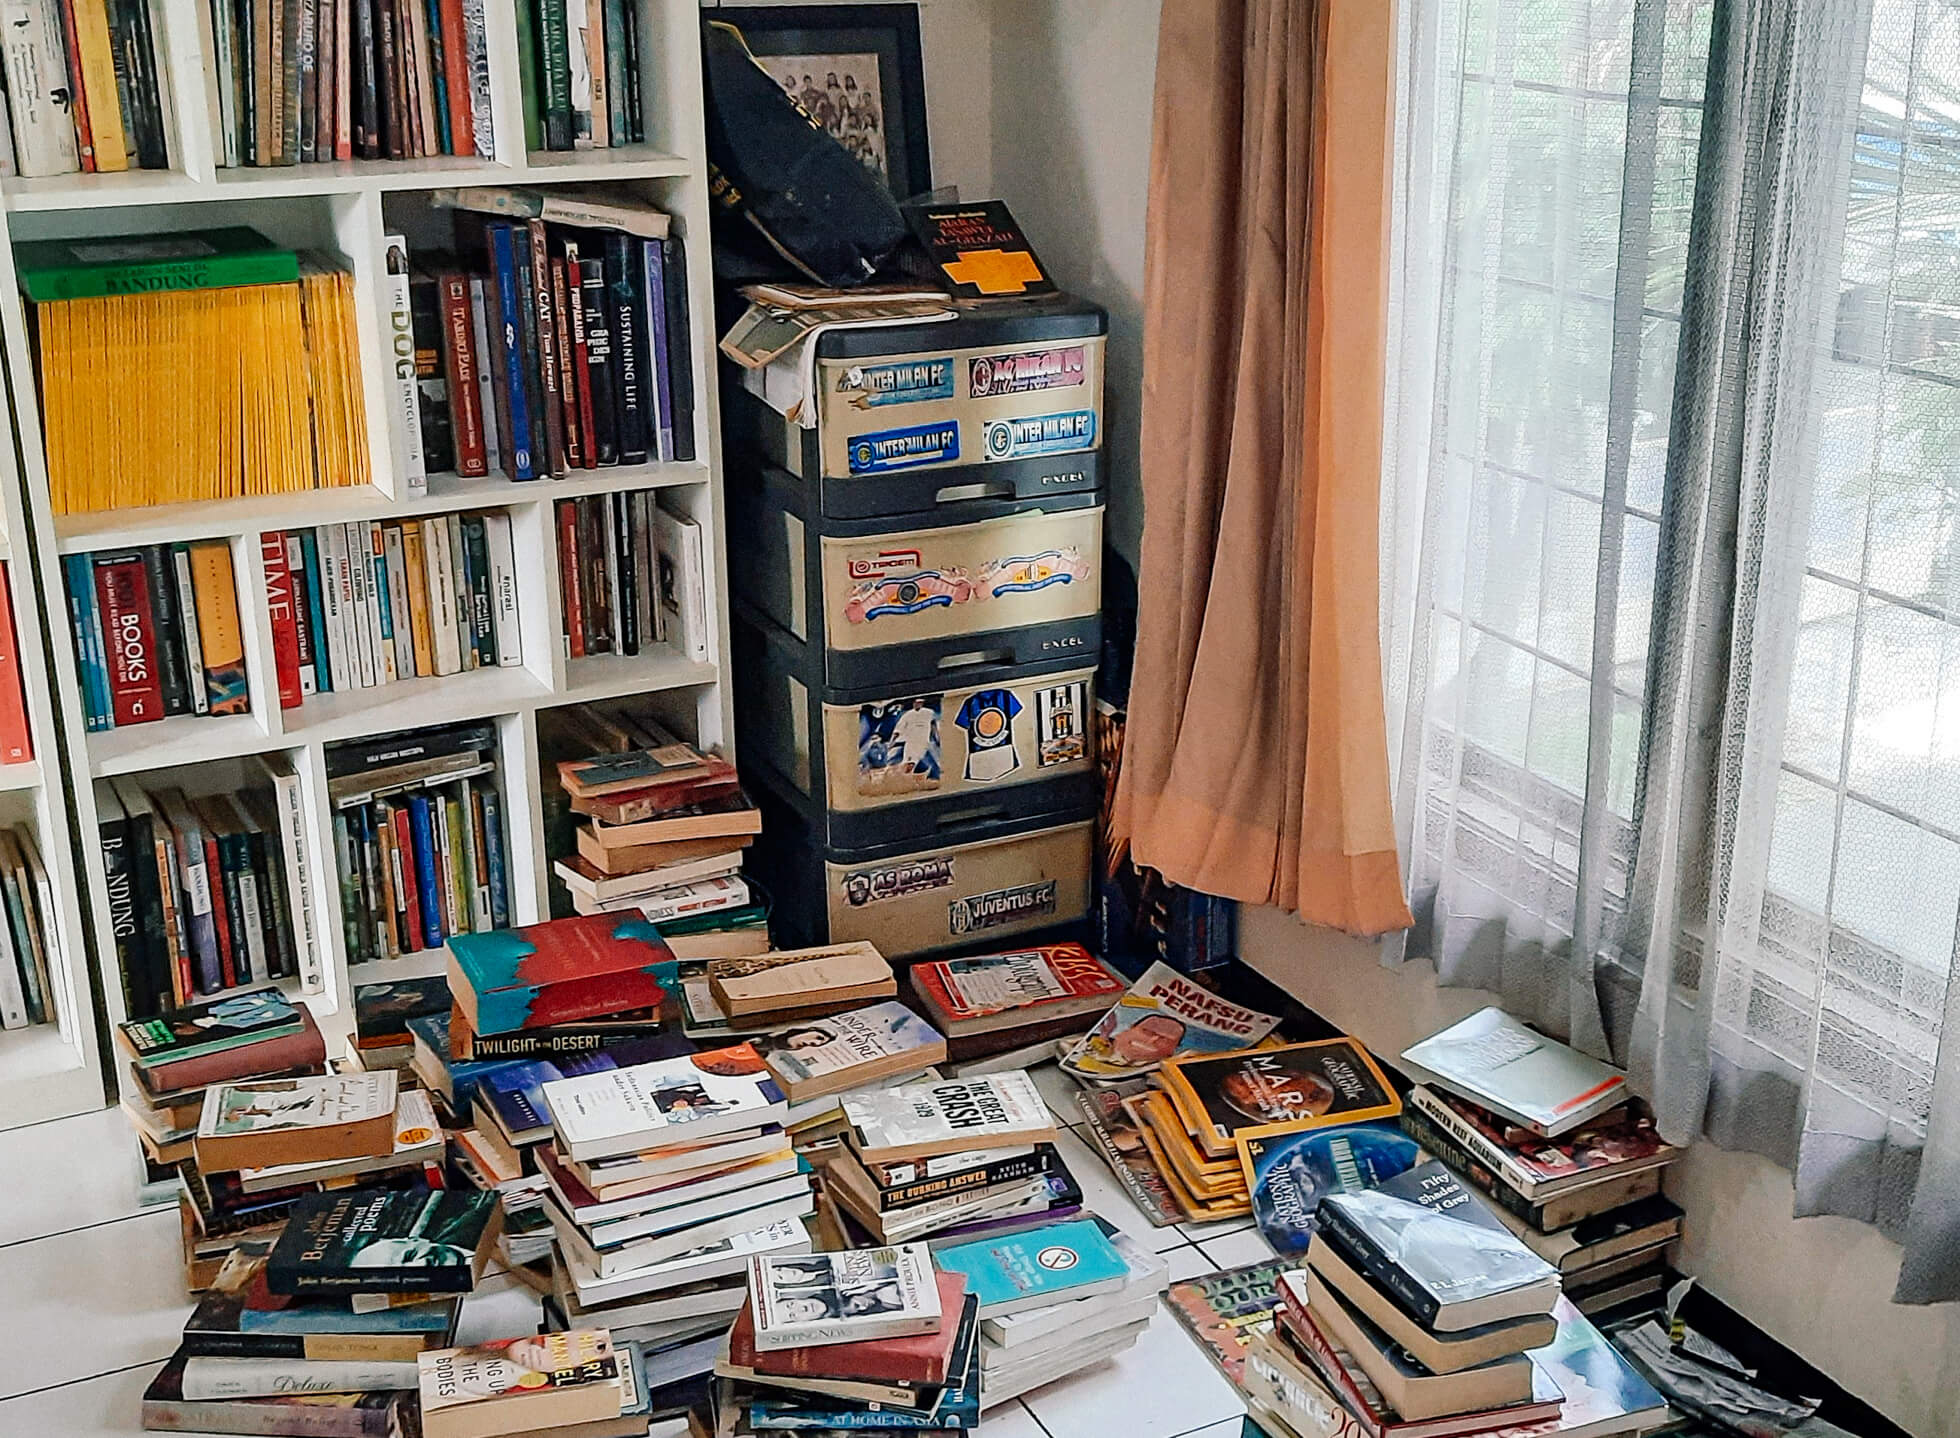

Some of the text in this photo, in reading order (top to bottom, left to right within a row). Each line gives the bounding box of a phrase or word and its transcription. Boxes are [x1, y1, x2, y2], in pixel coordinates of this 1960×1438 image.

[106, 273, 208, 293] BANDUNG
[538, 292, 552, 322] CAT
[571, 287, 585, 344] PROPAGANDA
[620, 305, 637, 410] SUSTAINING LIFE
[391, 287, 418, 461] THE DOG ENCYCLOPEDIA
[896, 367, 929, 388] MILAN
[931, 365, 945, 386] FC
[875, 430, 954, 459] INTER MILAN FC
[1013, 415, 1089, 444] INTER MILAN FC
[104, 571, 116, 588] YOU
[261, 533, 290, 621] TIME
[503, 575, 514, 611] #narasi
[120, 614, 147, 681] BOOKS
[1042, 637, 1084, 650] EXCEL
[874, 861, 950, 891] AS ROMA
[972, 889, 1052, 918] JUVENTUS FC
[1150, 984, 1253, 1034] PERANG
[1169, 979, 1255, 1022] NAFSU
[837, 1013, 876, 1043] UNDER
[475, 1037, 536, 1055] TWILIGHT
[553, 1034, 601, 1051] DESERT
[847, 1036, 879, 1059] WIRE
[968, 1081, 1010, 1124] THE GREAT
[1252, 1056, 1313, 1120] MARS
[913, 1102, 935, 1118] 1929
[932, 1085, 986, 1129] CRASH
[1425, 1102, 1452, 1129] MODERN
[888, 1170, 988, 1203] THE BURNING ANSWER
[1280, 1162, 1309, 1229] GEOGRAPHIC
[1418, 1182, 1461, 1205] Shades
[1421, 1172, 1450, 1190] Fifty
[1268, 1170, 1287, 1223] NATIONAL
[1431, 1193, 1471, 1215] of Grey
[342, 1206, 368, 1243] collected
[359, 1196, 387, 1232] poems
[302, 1198, 353, 1261] Betjeman
[1453, 1273, 1488, 1287] James
[551, 1332, 576, 1387] MANTEL
[578, 1332, 605, 1378] HILARY
[273, 1374, 334, 1393] Deluxe
[436, 1357, 456, 1397] BODIES
[463, 1362, 480, 1384] THE
[487, 1380, 506, 1396] UP
[832, 1411, 941, 1428] AT HOME IN ASIA
